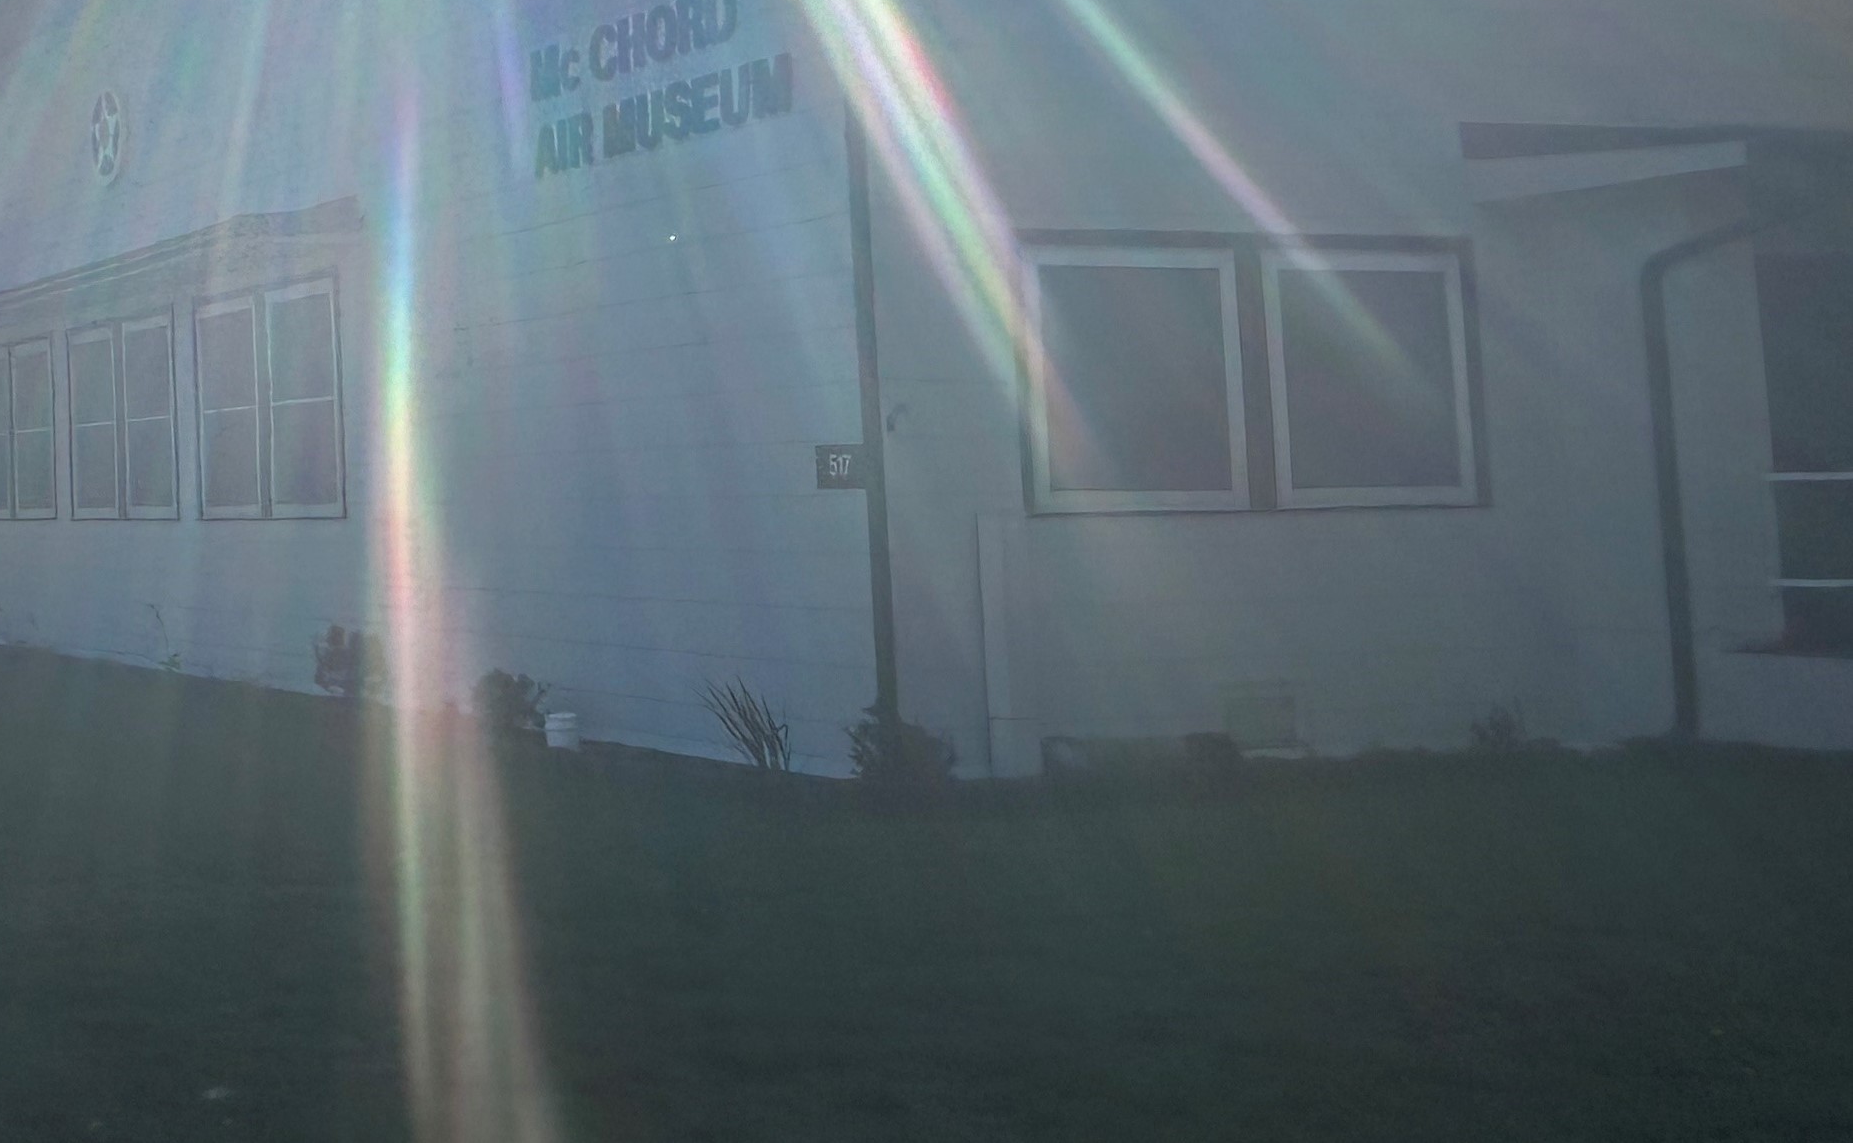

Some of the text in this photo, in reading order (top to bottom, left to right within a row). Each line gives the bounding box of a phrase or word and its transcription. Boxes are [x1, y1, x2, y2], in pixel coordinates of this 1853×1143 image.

[534, 52, 794, 179] AIR MUSEUM
[829, 453, 852, 477] 517
